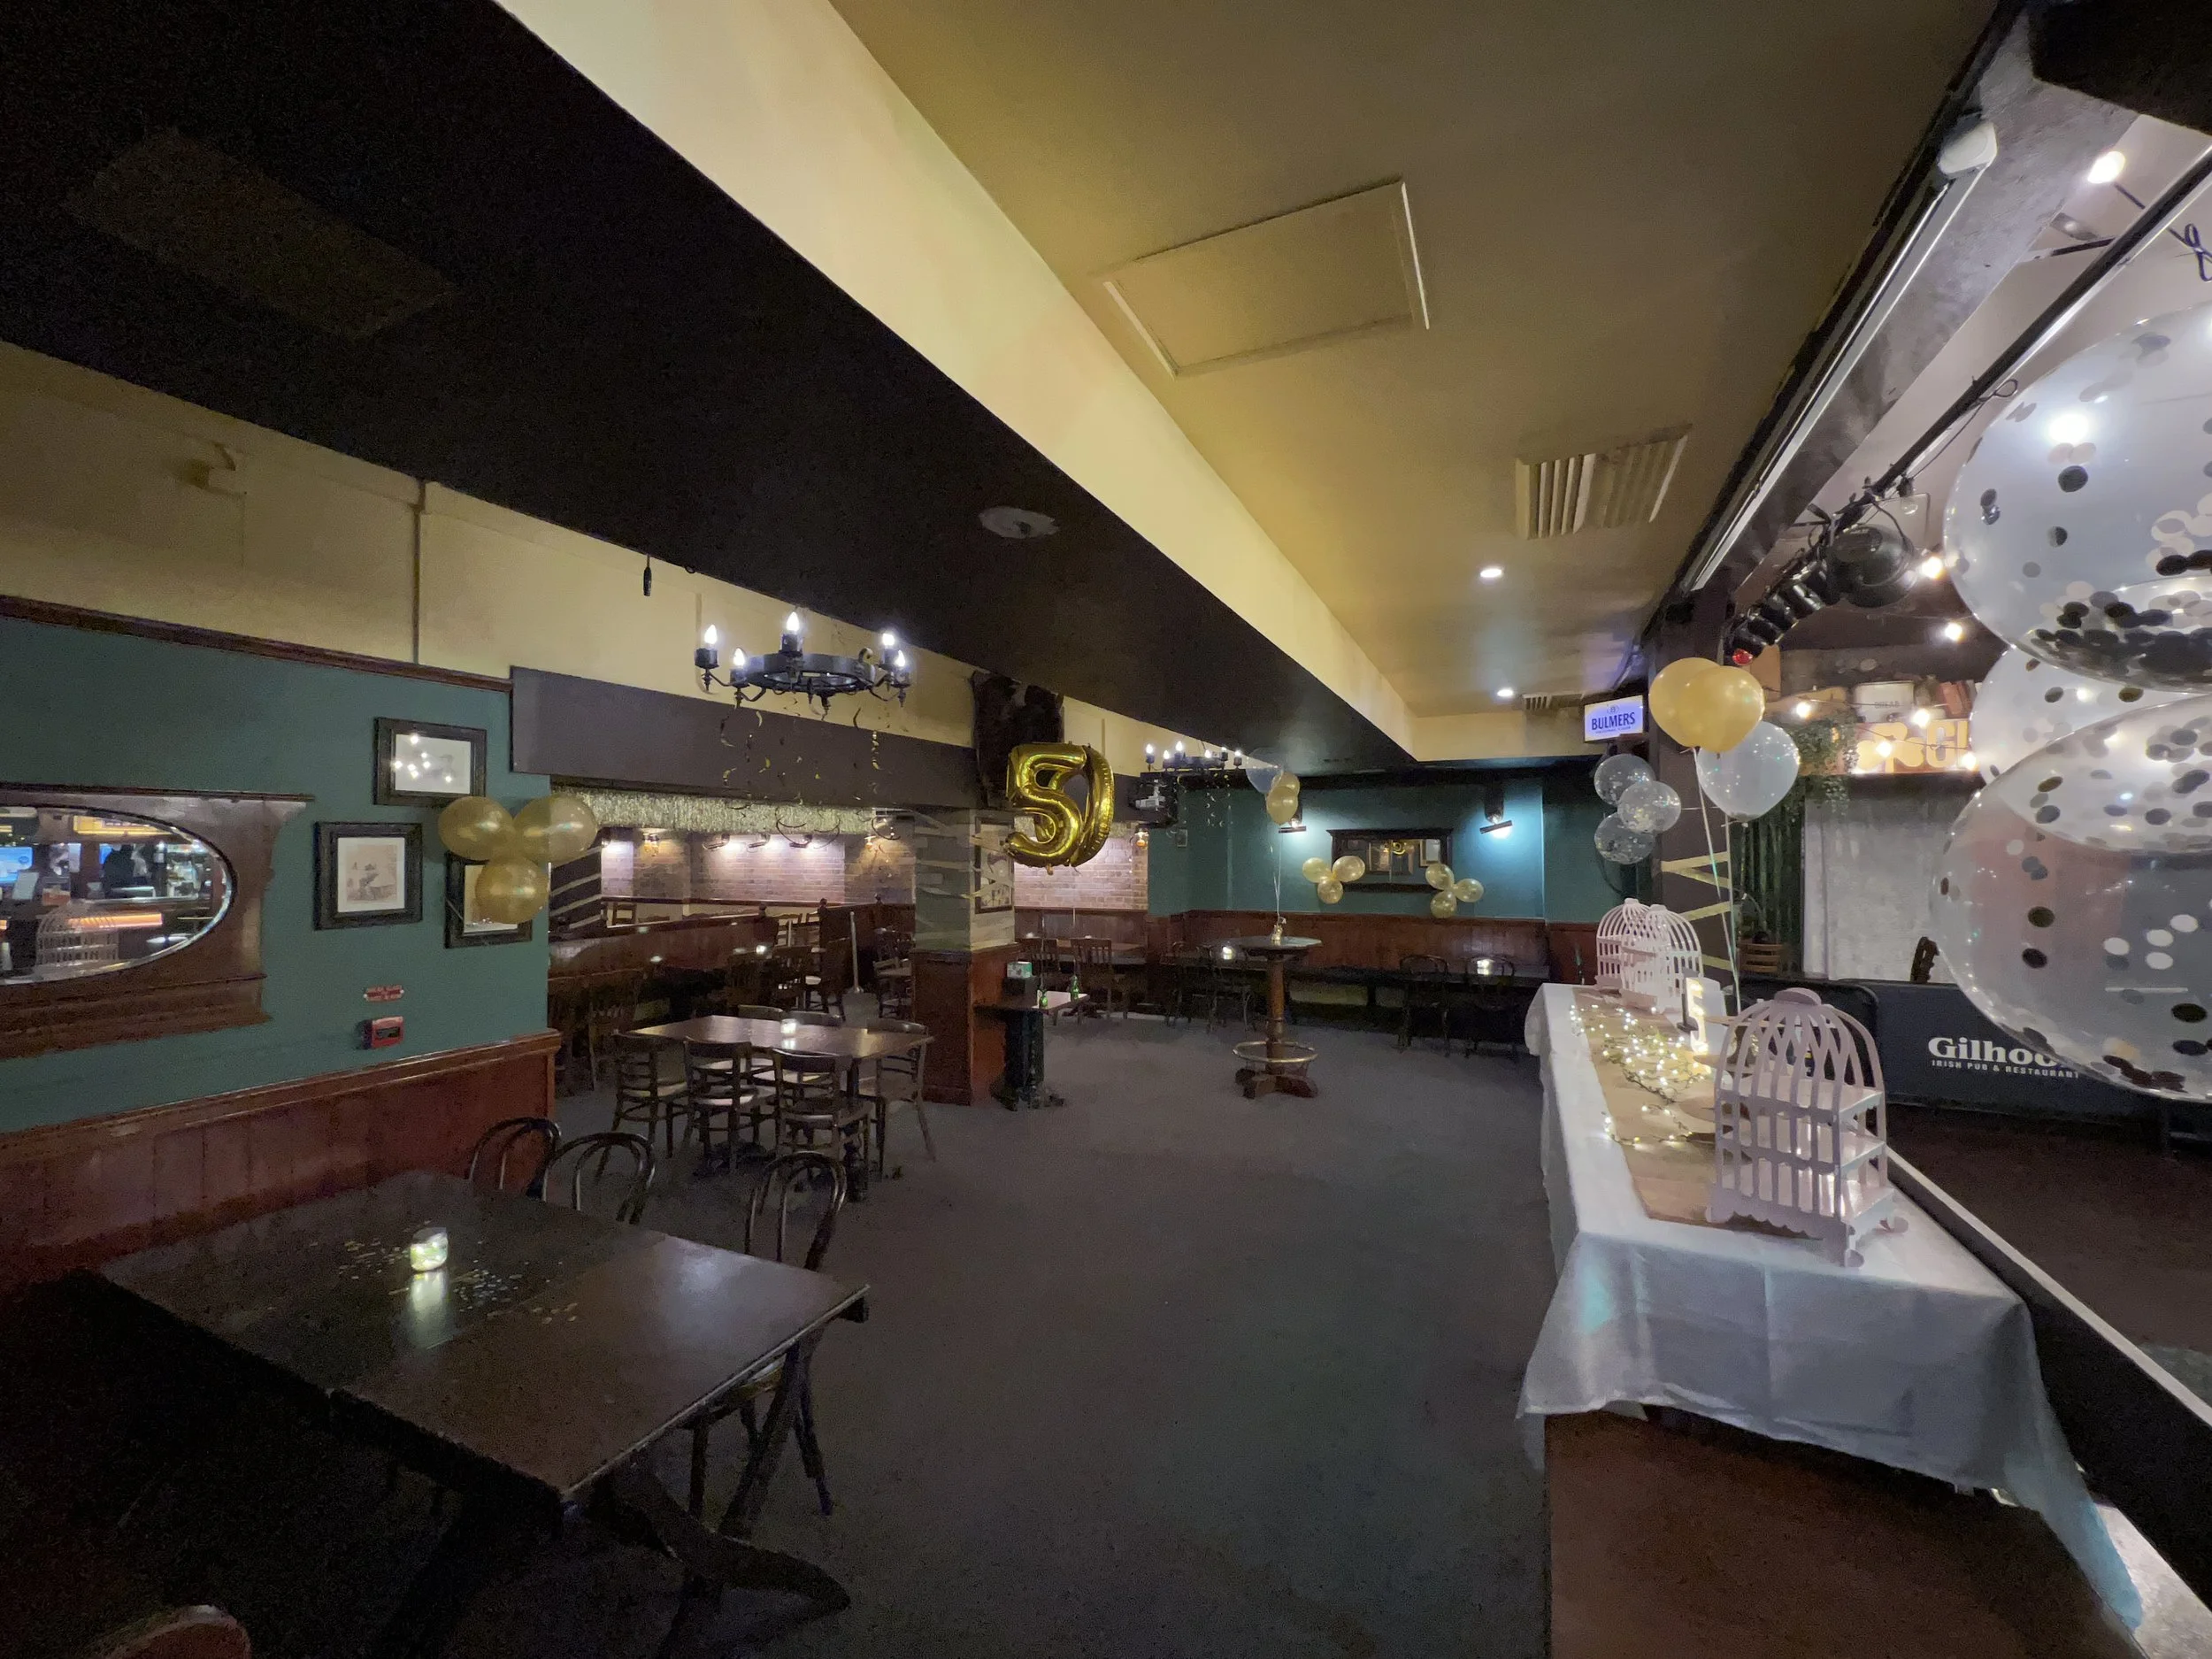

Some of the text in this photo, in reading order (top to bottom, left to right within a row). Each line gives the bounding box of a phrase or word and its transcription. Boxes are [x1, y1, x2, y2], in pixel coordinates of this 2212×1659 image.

[1592, 712, 1635, 731] BULMERS
[1928, 1036, 2065, 1067] Gilhoo
[1932, 1060, 1962, 1069] IRISH
[1967, 1062, 1988, 1071] PUB
[2005, 1065, 2079, 1079] RESTAURANT
